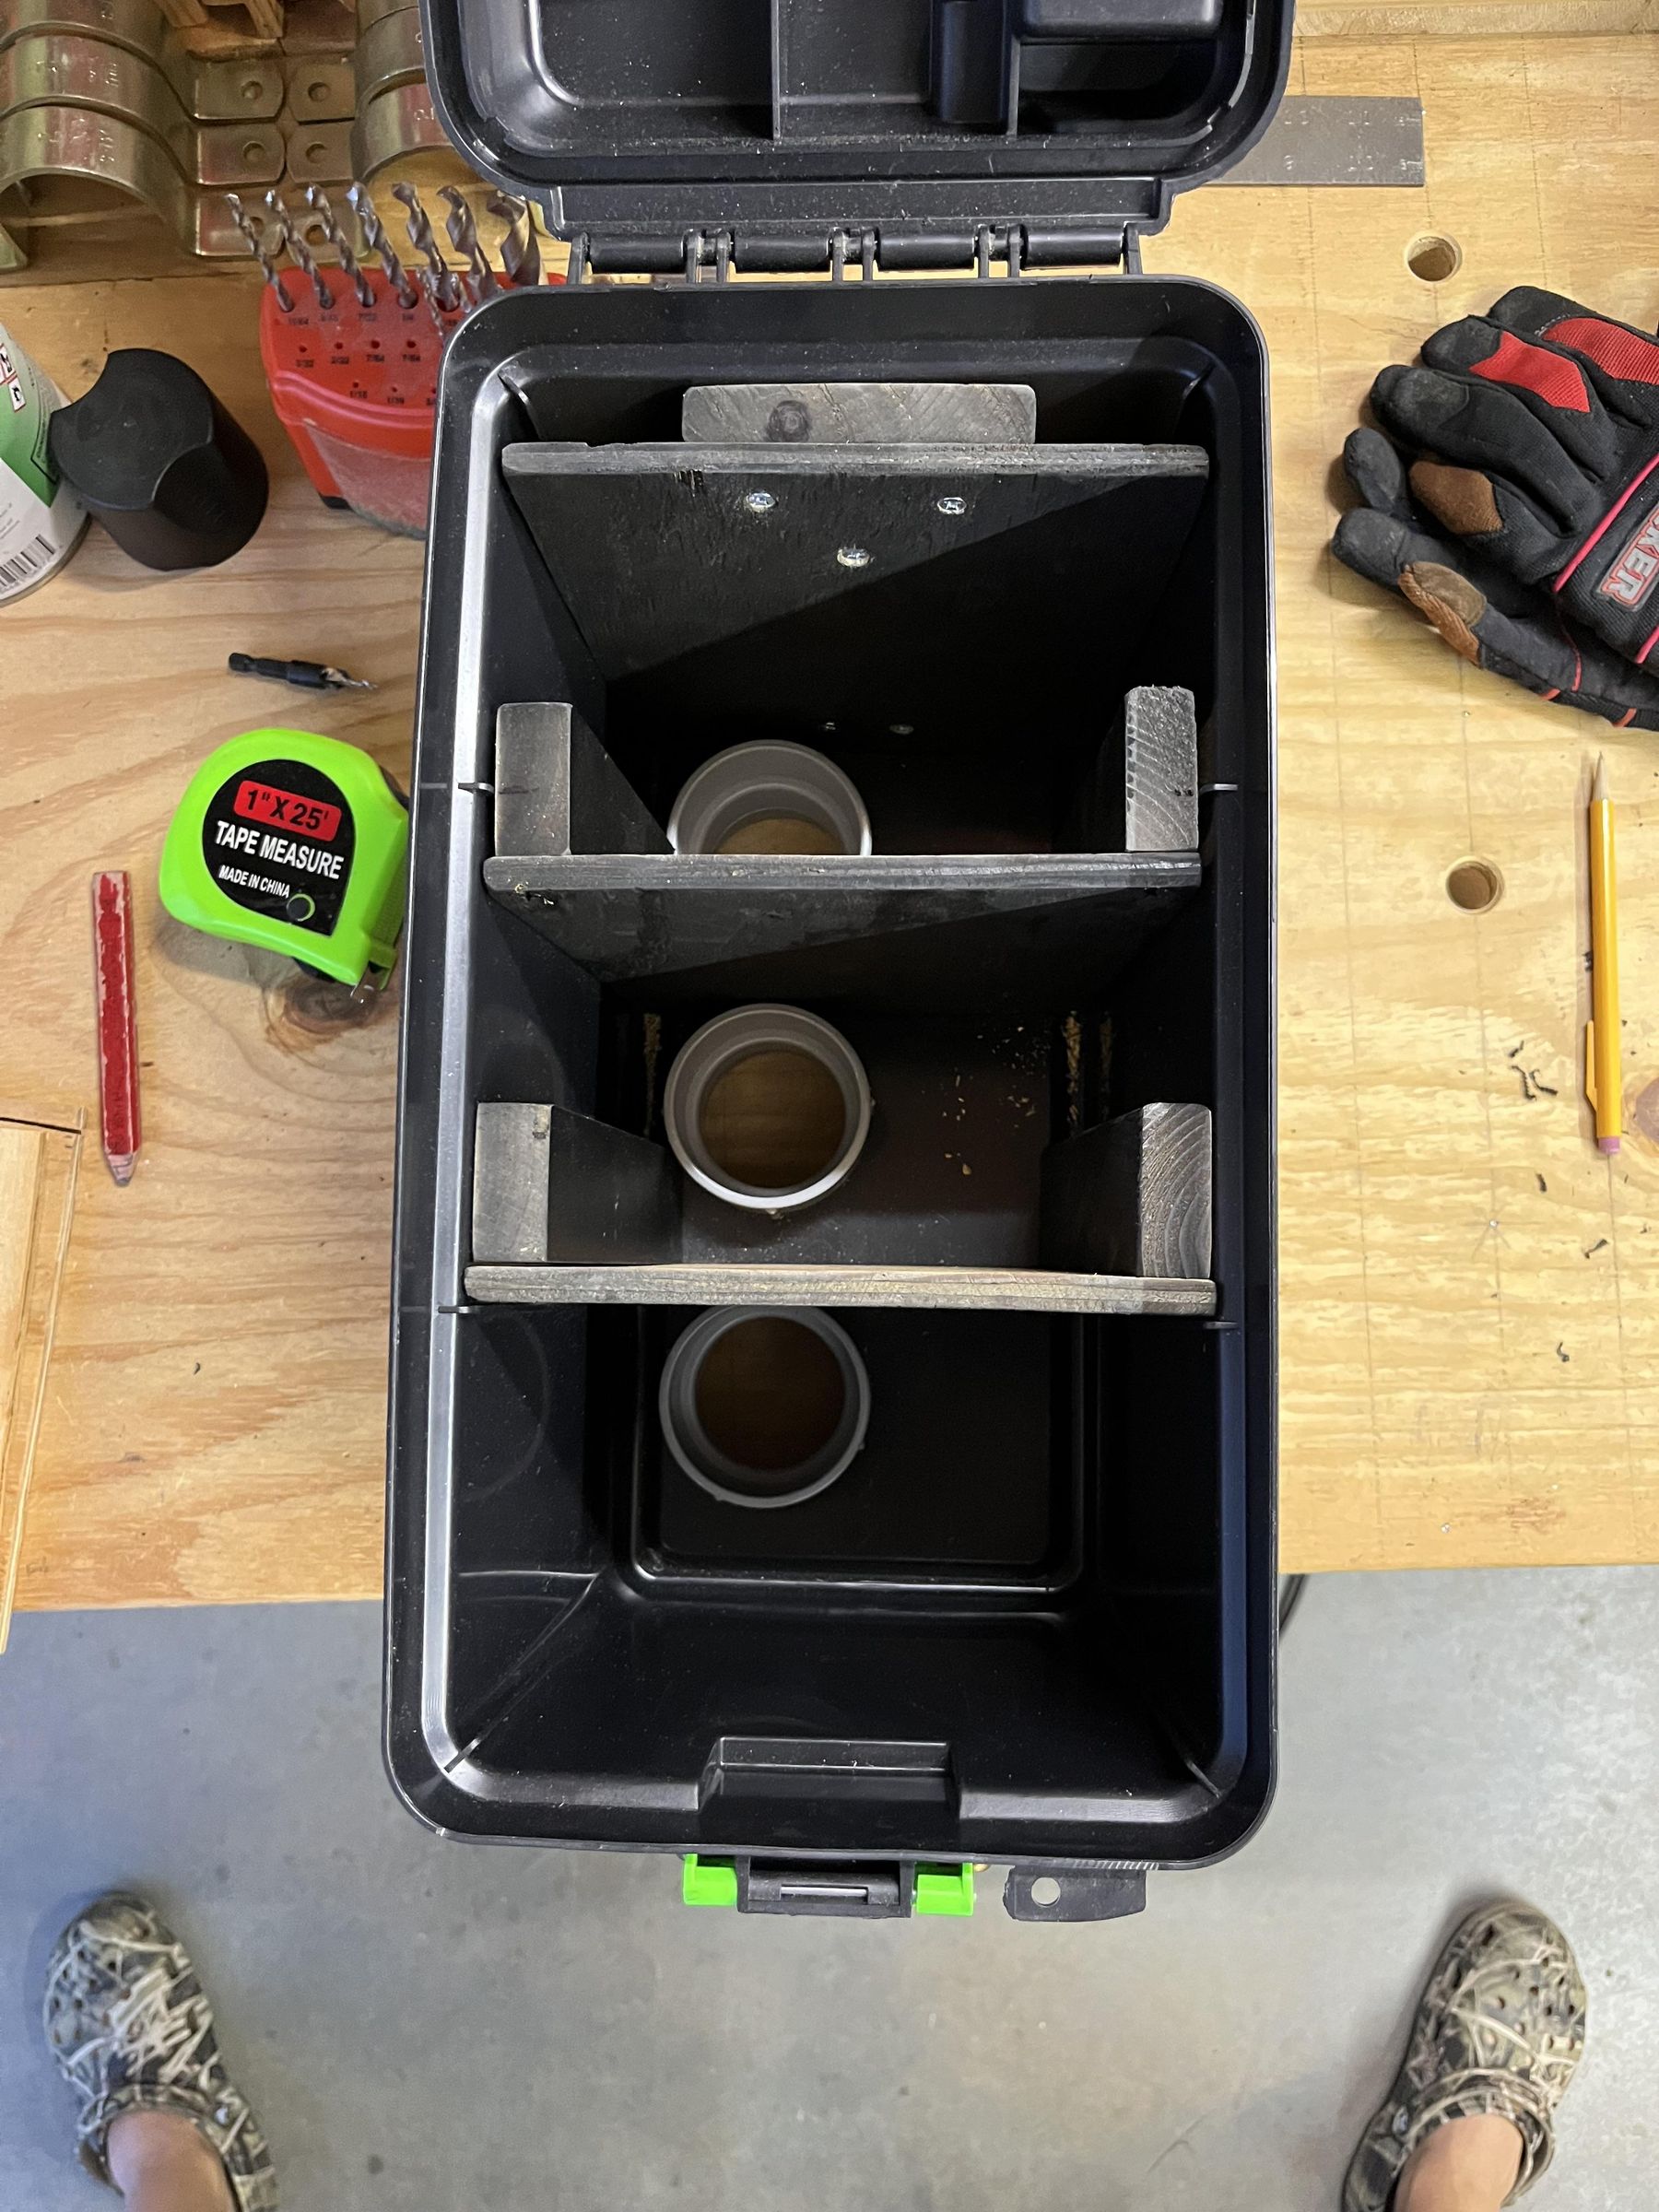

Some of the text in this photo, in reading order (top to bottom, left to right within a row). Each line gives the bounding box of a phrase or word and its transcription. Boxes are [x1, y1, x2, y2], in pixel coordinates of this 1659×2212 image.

[1608, 514, 1659, 601] KER
[215, 820, 345, 879] TAPE MEASURE
[218, 865, 291, 899] MADE IN CHINA
